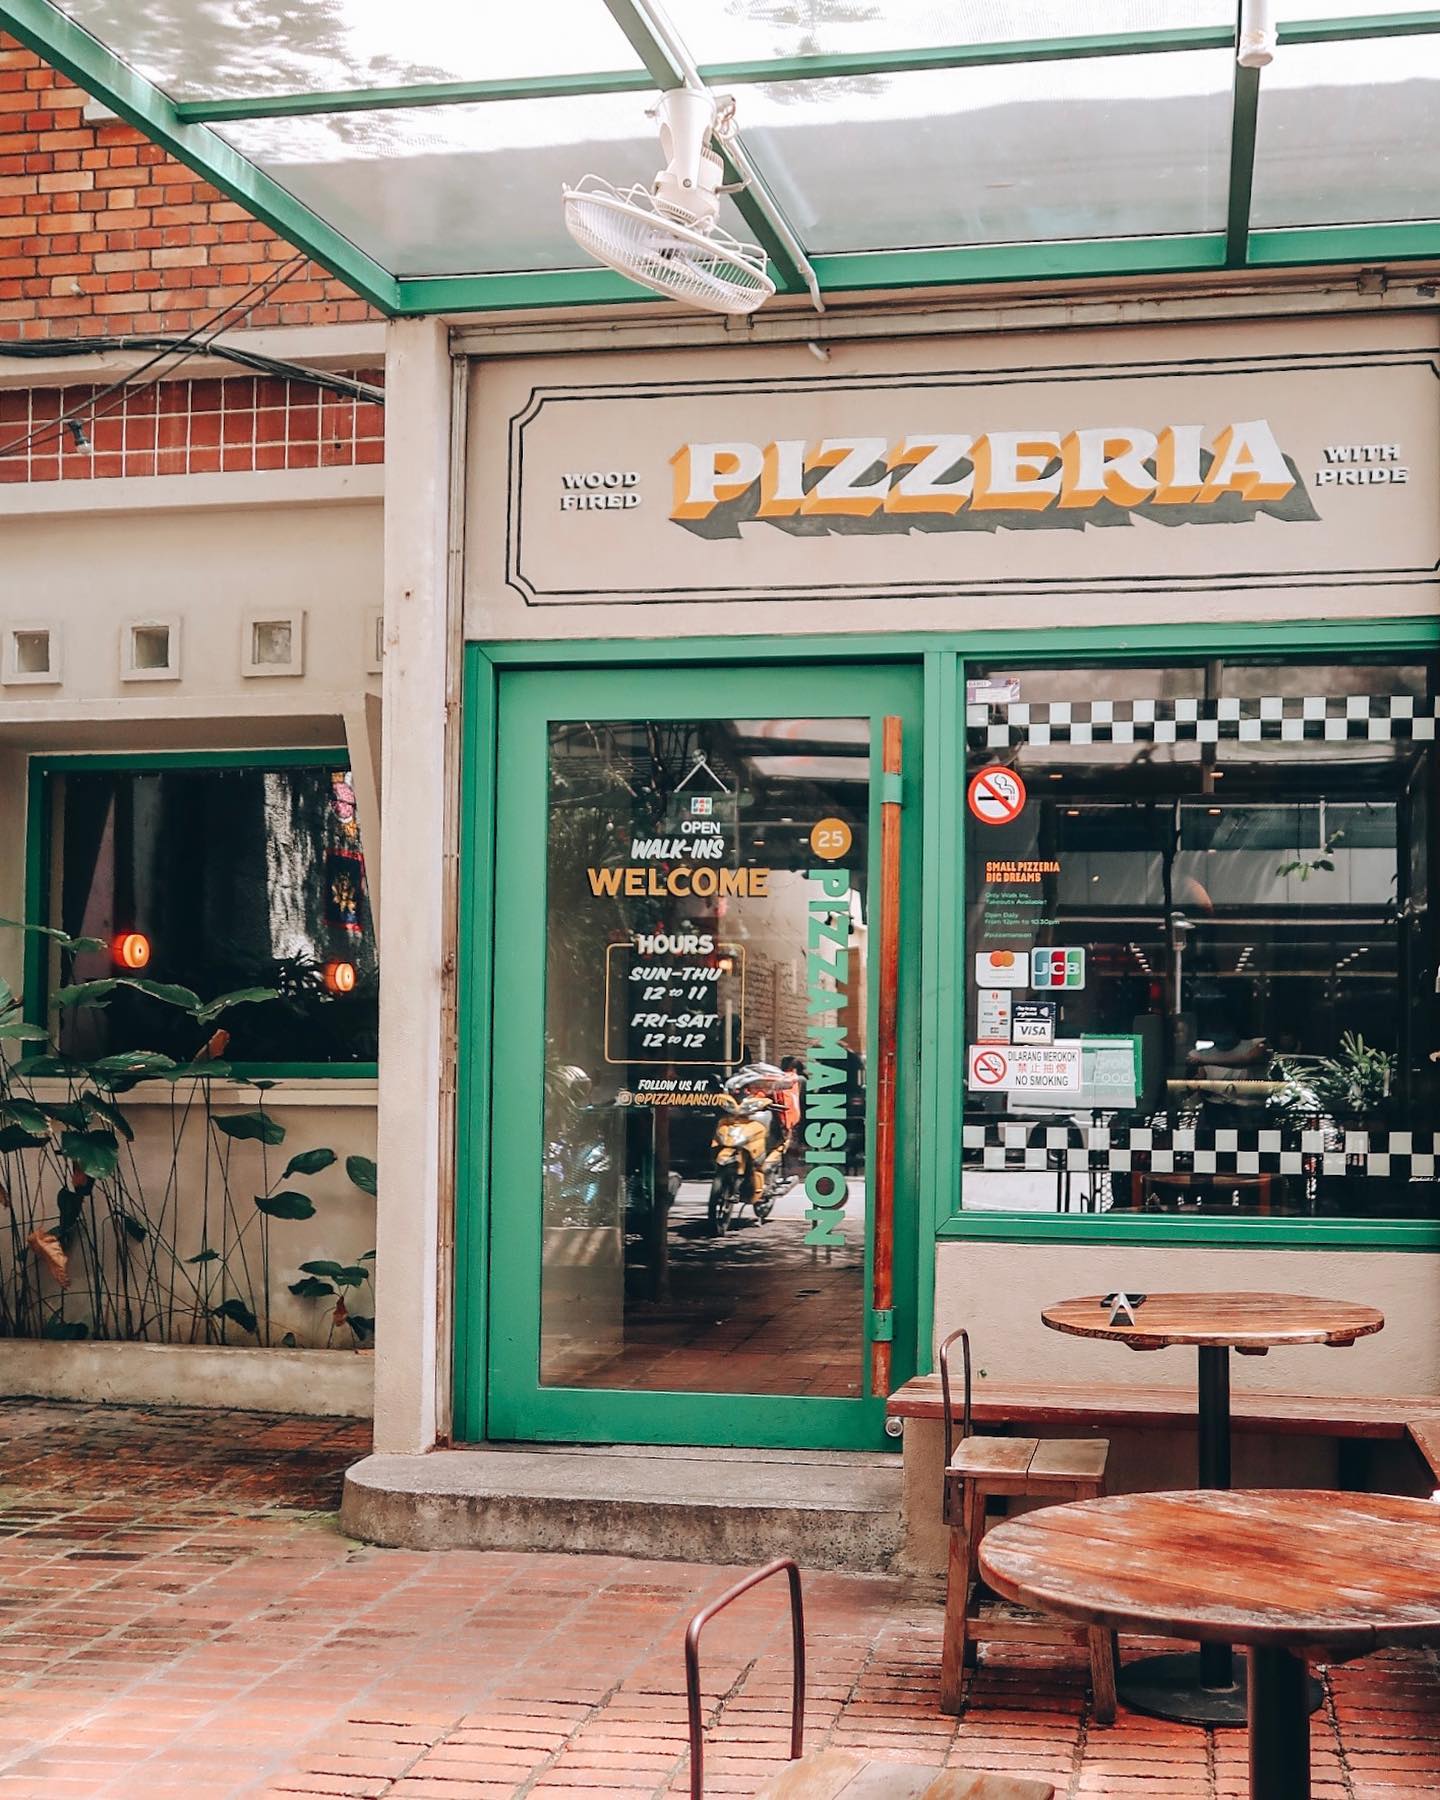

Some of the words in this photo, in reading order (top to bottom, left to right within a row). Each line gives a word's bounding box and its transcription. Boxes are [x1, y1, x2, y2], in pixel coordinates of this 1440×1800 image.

[1323, 445, 1400, 463] WITH
[561, 472, 641, 489] WOOD
[670, 419, 1320, 540] PIZZERIA
[1315, 467, 1408, 486] PRIDE
[560, 493, 642, 511] FIRED
[681, 821, 720, 834] OPEN
[817, 830, 844, 848] 25
[631, 838, 724, 859] WALK-INS
[985, 861, 1017, 872] SMALL
[1018, 861, 1060, 872] PIZZERIA
[587, 866, 770, 898] WELCOME
[985, 872, 1002, 883] BIG
[1003, 872, 1042, 883] DREAMS
[637, 934, 714, 955] HOURS
[807, 868, 850, 1015] PIZZA
[628, 966, 722, 981] SUN-THU
[1034, 962, 1080, 976] JCB
[642, 986, 666, 1001] 12
[668, 988, 683, 997] to
[687, 986, 708, 1001] 11
[630, 1013, 718, 1028] FRI-SAT
[1020, 1026, 1046, 1036] VISA
[642, 1033, 665, 1047] 12
[667, 1034, 681, 1044] to
[682, 1033, 706, 1047] 12
[1008, 1051, 1042, 1062] DILARANG
[1043, 1051, 1077, 1063] MEROKOK
[638, 1080, 678, 1091] FOLLOW
[678, 1080, 691, 1091] US
[693, 1080, 708, 1091] AT
[1015, 1076, 1028, 1086] NO
[1030, 1076, 1069, 1086] SMOKING
[804, 1026, 848, 1245] MANSION
